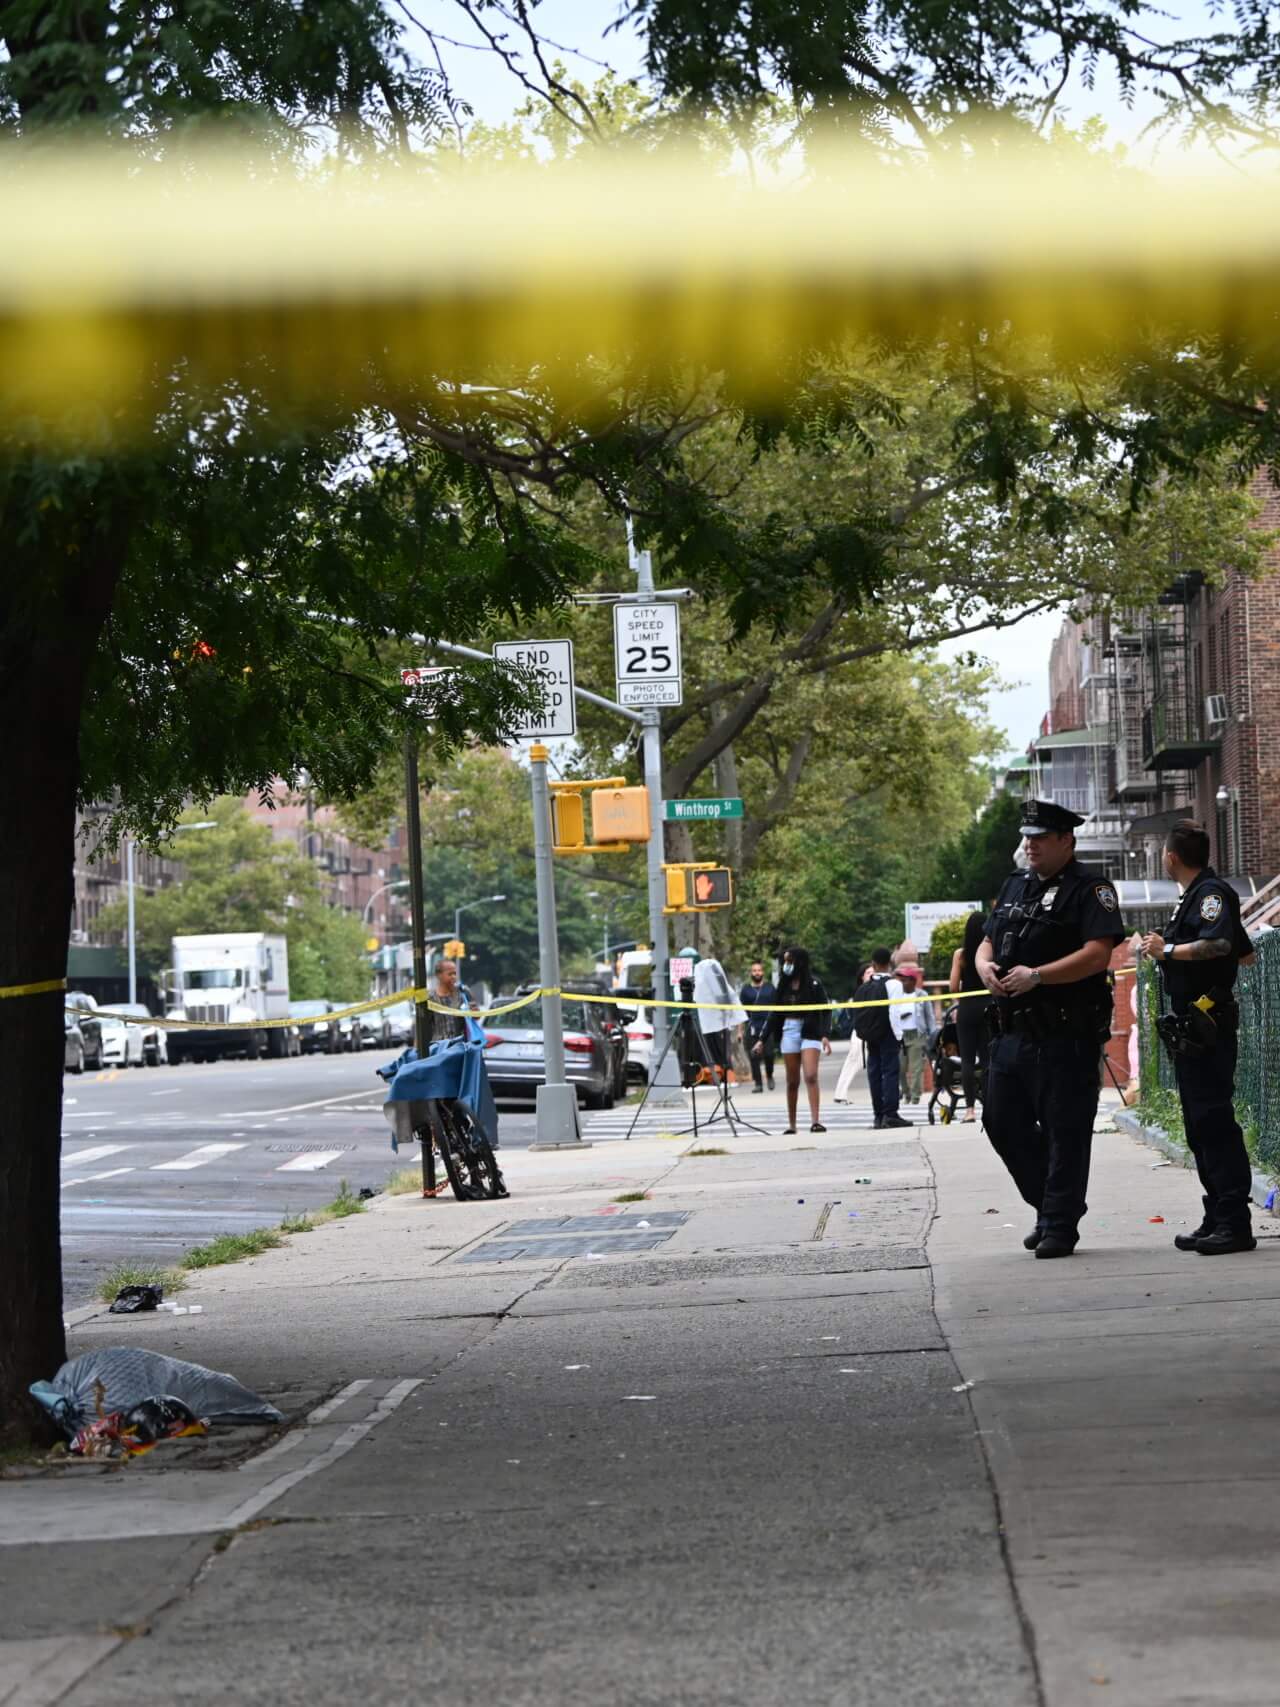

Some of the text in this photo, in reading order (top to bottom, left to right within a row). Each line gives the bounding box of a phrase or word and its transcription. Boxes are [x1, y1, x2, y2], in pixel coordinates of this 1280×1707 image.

[633, 609, 658, 618] CITY
[627, 620, 664, 630] SPEED
[632, 632, 661, 642] LIMIT
[516, 650, 550, 665] END
[626, 646, 671, 673] 25
[633, 684, 665, 692] PHOTO
[623, 692, 675, 702] ENFORCED
[674, 800, 732, 818] Winthrop St
